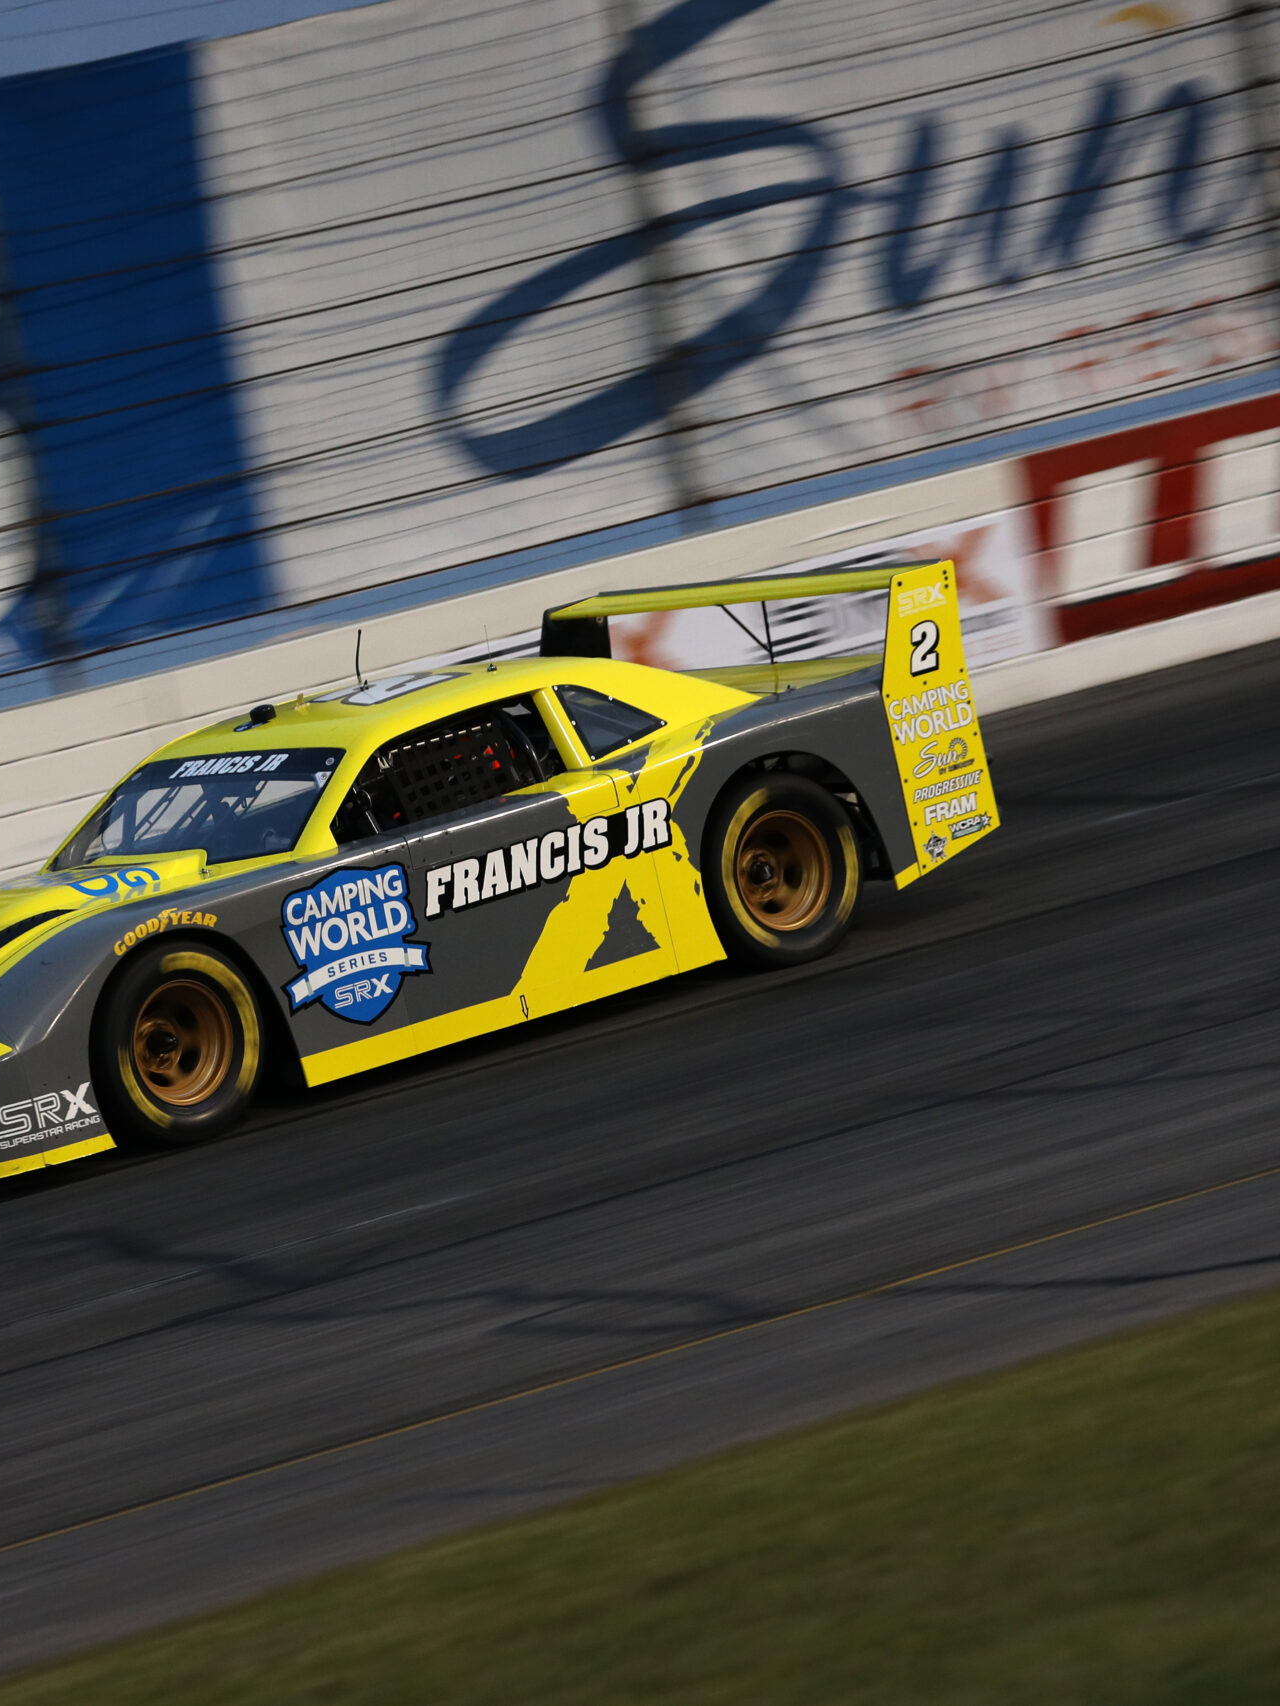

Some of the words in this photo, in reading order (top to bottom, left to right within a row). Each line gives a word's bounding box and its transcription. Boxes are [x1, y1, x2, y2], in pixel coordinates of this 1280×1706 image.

[897, 582, 945, 613] SRX
[910, 619, 940, 677] 2
[888, 679, 970, 721] CAMPING
[892, 702, 973, 745] WORLD
[170, 754, 261, 779] FRANCIS
[256, 753, 289, 771] JR
[913, 740, 960, 779] Sun
[913, 769, 983, 804] PROGRESSIVE
[924, 791, 978, 826] FRAM
[425, 815, 610, 918] FRANCIS
[623, 798, 670, 855] JR
[286, 869, 403, 926] CAMPING
[114, 907, 217, 956] GOODYEAR
[288, 900, 408, 960] WORLD
[327, 952, 388, 978] SERIES
[334, 973, 393, 1009] SRX
[0, 1126, 64, 1149] SUPERSTAR
[65, 1115, 101, 1131] RACING
